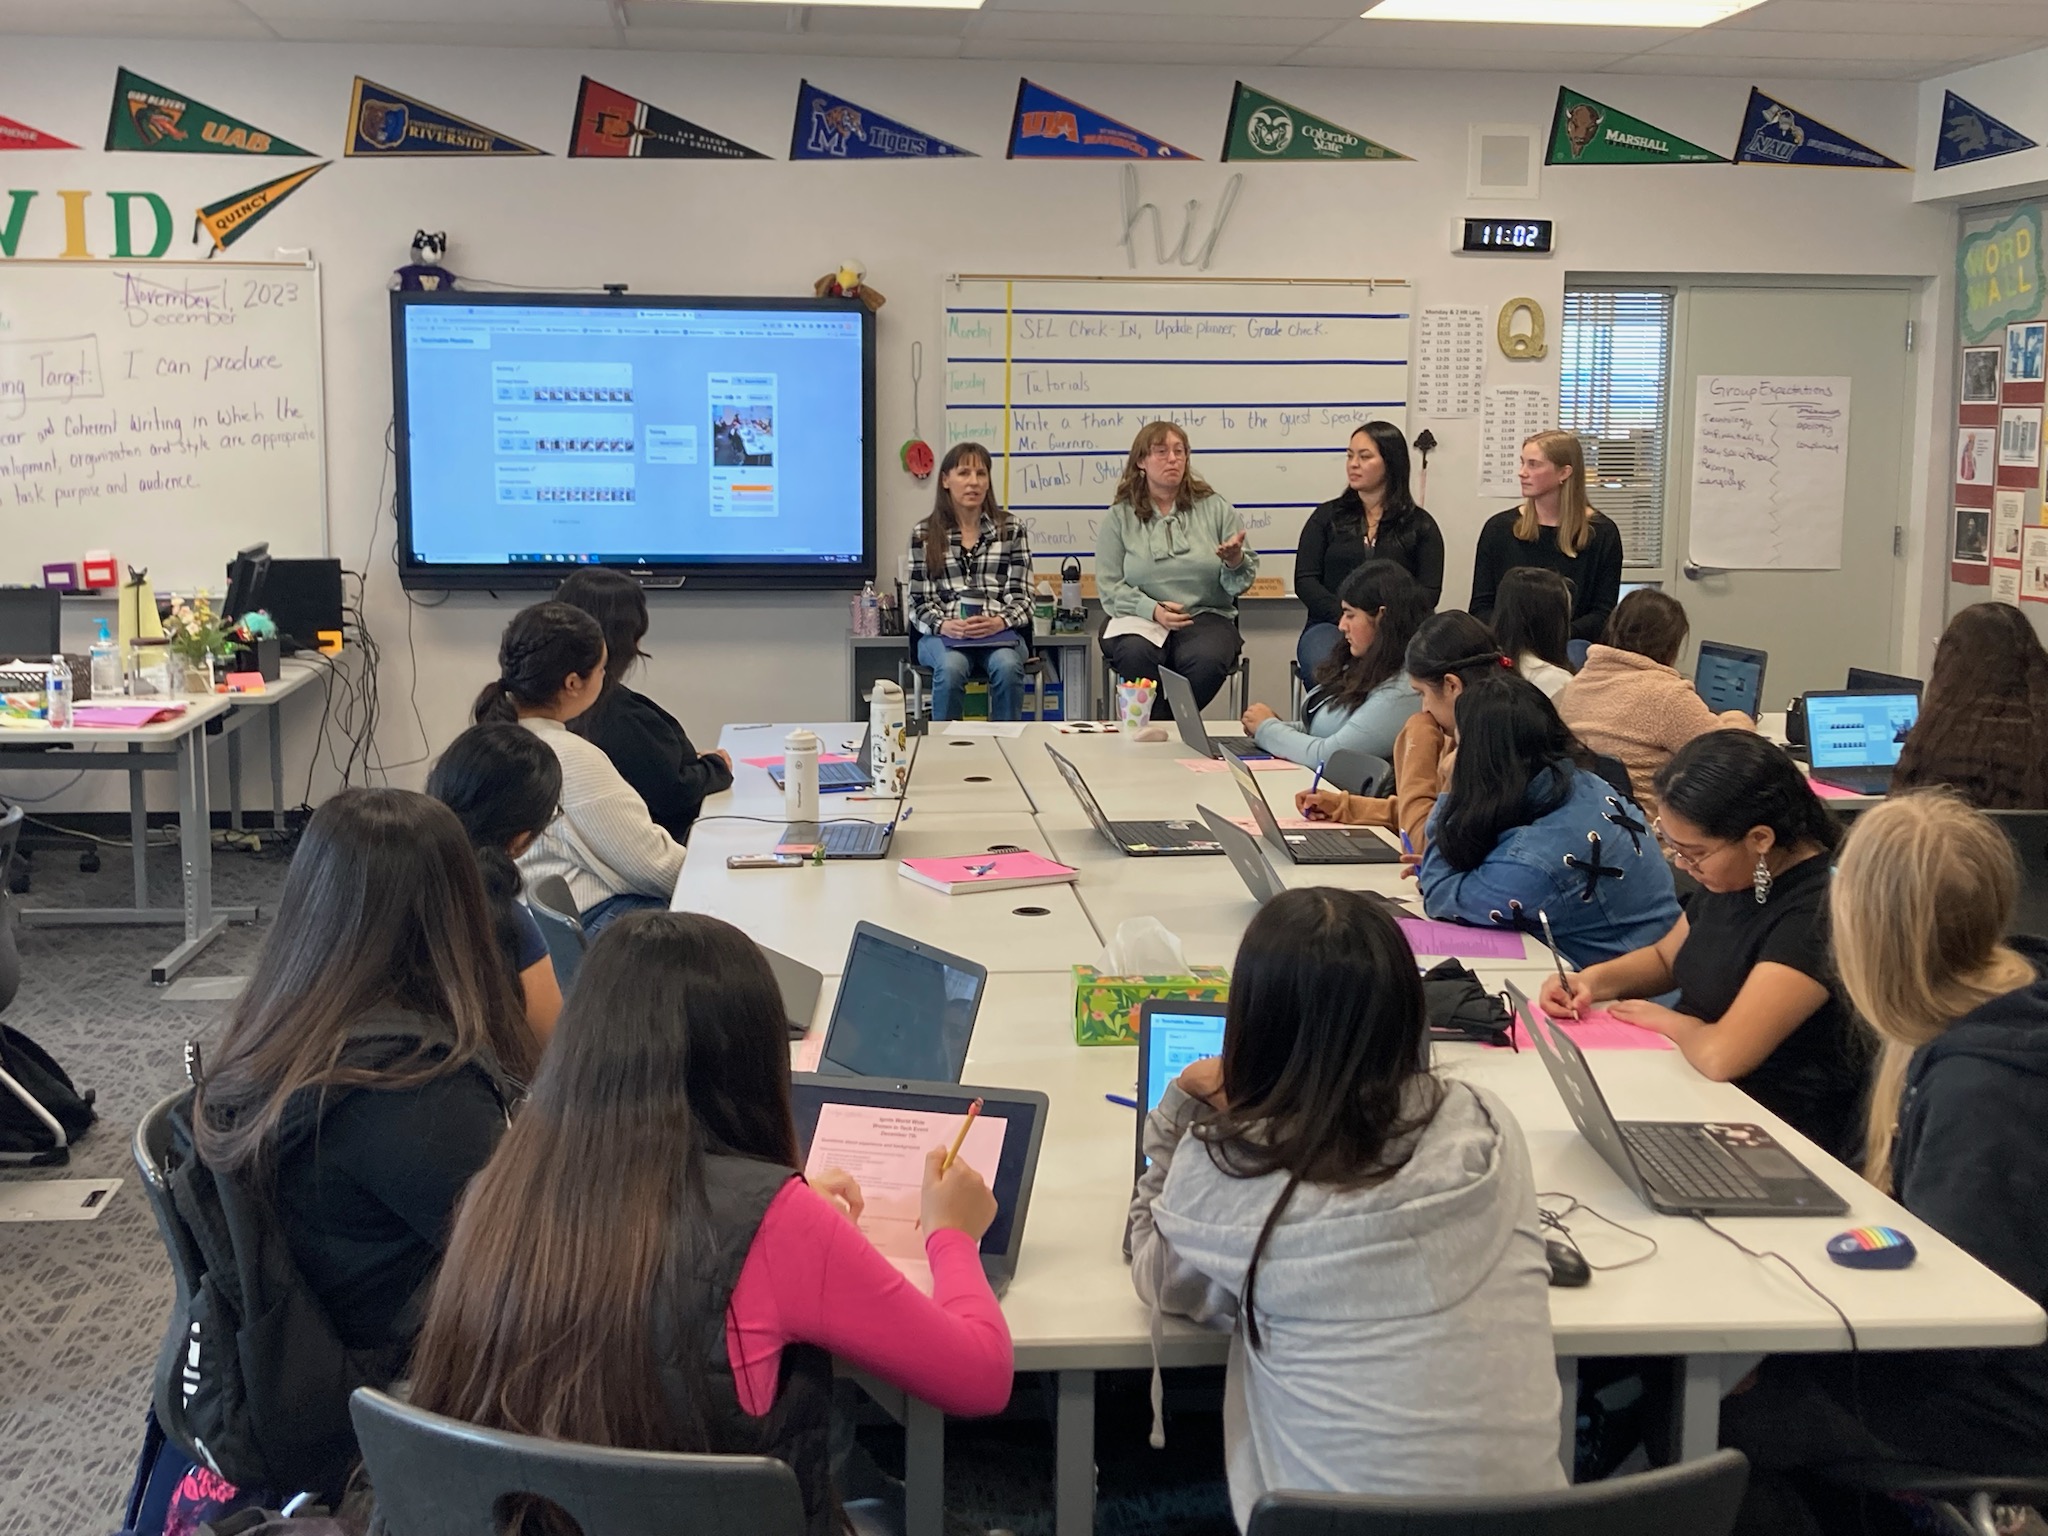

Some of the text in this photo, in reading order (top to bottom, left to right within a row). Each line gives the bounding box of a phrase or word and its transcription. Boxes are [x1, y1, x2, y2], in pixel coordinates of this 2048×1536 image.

[201, 122, 271, 152] UAB
[409, 125, 493, 152] RIVERSIDE
[869, 126, 928, 155] Tigers
[1302, 125, 1358, 146] Colorado
[1313, 138, 1343, 153] State
[1605, 129, 1669, 152] MARSHALL
[216, 192, 268, 230] QUINCY
[1483, 226, 1538, 247] 11:02
[244, 280, 298, 308] 2023
[124, 304, 236, 328] December
[1497, 297, 1549, 360] Q
[949, 316, 992, 347] Monday
[1020, 318, 1060, 339] SEL
[156, 356, 190, 377] can
[204, 346, 282, 381] produce
[1017, 370, 1091, 395] Tutorials
[1710, 378, 1757, 400] Group
[1013, 411, 1048, 432] Write
[1061, 418, 1071, 429] a
[1082, 412, 1124, 430] thank
[1221, 411, 1235, 429] to
[1248, 411, 1268, 429] the
[1280, 410, 1311, 437] guest
[55, 486, 100, 508] purpose
[107, 472, 128, 494] and
[1016, 460, 1072, 493] Tutorials
